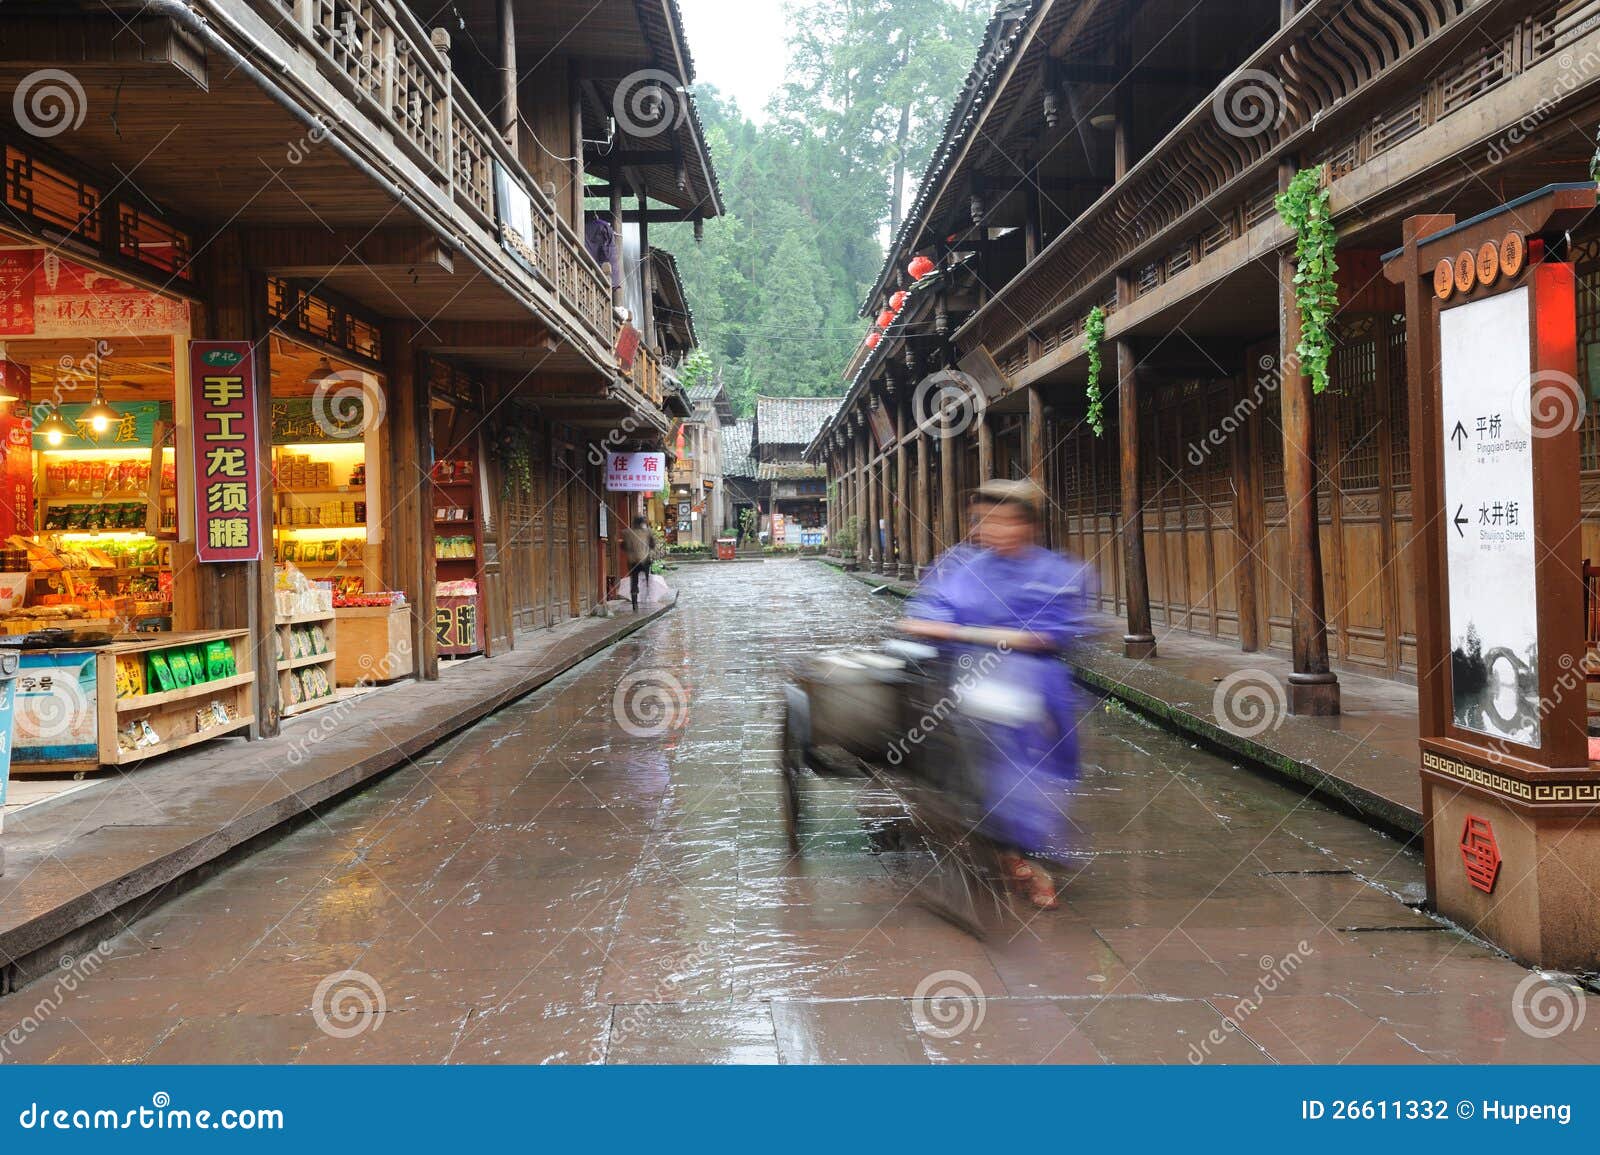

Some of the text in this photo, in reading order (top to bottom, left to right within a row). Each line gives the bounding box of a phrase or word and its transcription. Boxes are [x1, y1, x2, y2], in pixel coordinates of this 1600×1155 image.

[1475, 413, 1502, 441] 平桥
[1477, 439, 1527, 456] Pingqiao Bridge
[203, 375, 249, 548] 手工龙须糖
[613, 456, 658, 472] 住宿
[1478, 500, 1519, 527] 水井街
[1479, 529, 1526, 543] Shuijing Street
[17, 676, 54, 692] 字号
